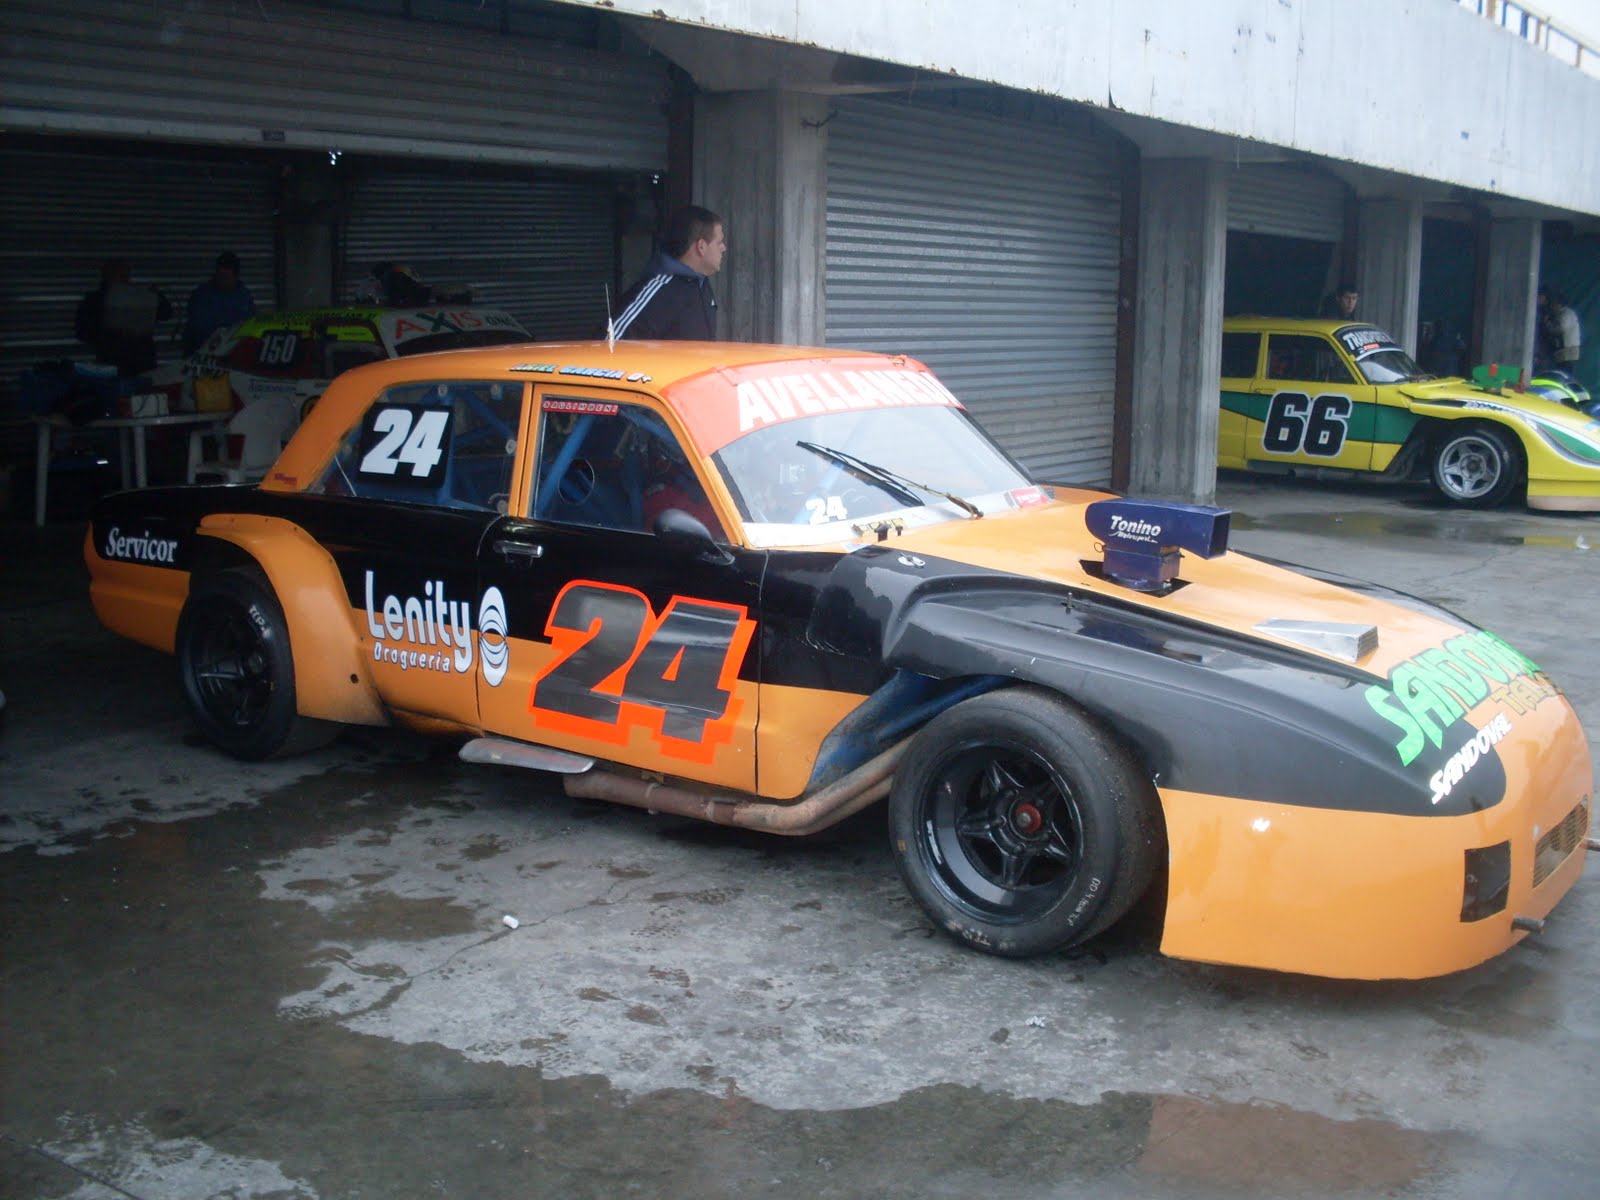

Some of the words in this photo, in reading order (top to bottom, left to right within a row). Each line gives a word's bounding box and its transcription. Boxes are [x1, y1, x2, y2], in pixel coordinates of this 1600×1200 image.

[395, 309, 483, 339] AXIS
[258, 334, 297, 364] 150
[559, 365, 628, 380] GARCIA
[1262, 391, 1353, 458] 66
[359, 409, 449, 478] 24
[805, 496, 848, 525] 24
[1110, 515, 1162, 537] Tonino
[105, 527, 178, 563] Servicor
[365, 570, 473, 674] Lenity
[373, 641, 451, 674] Drogueria
[528, 579, 757, 765] 24
[1429, 711, 1514, 805] SANDOVAL
